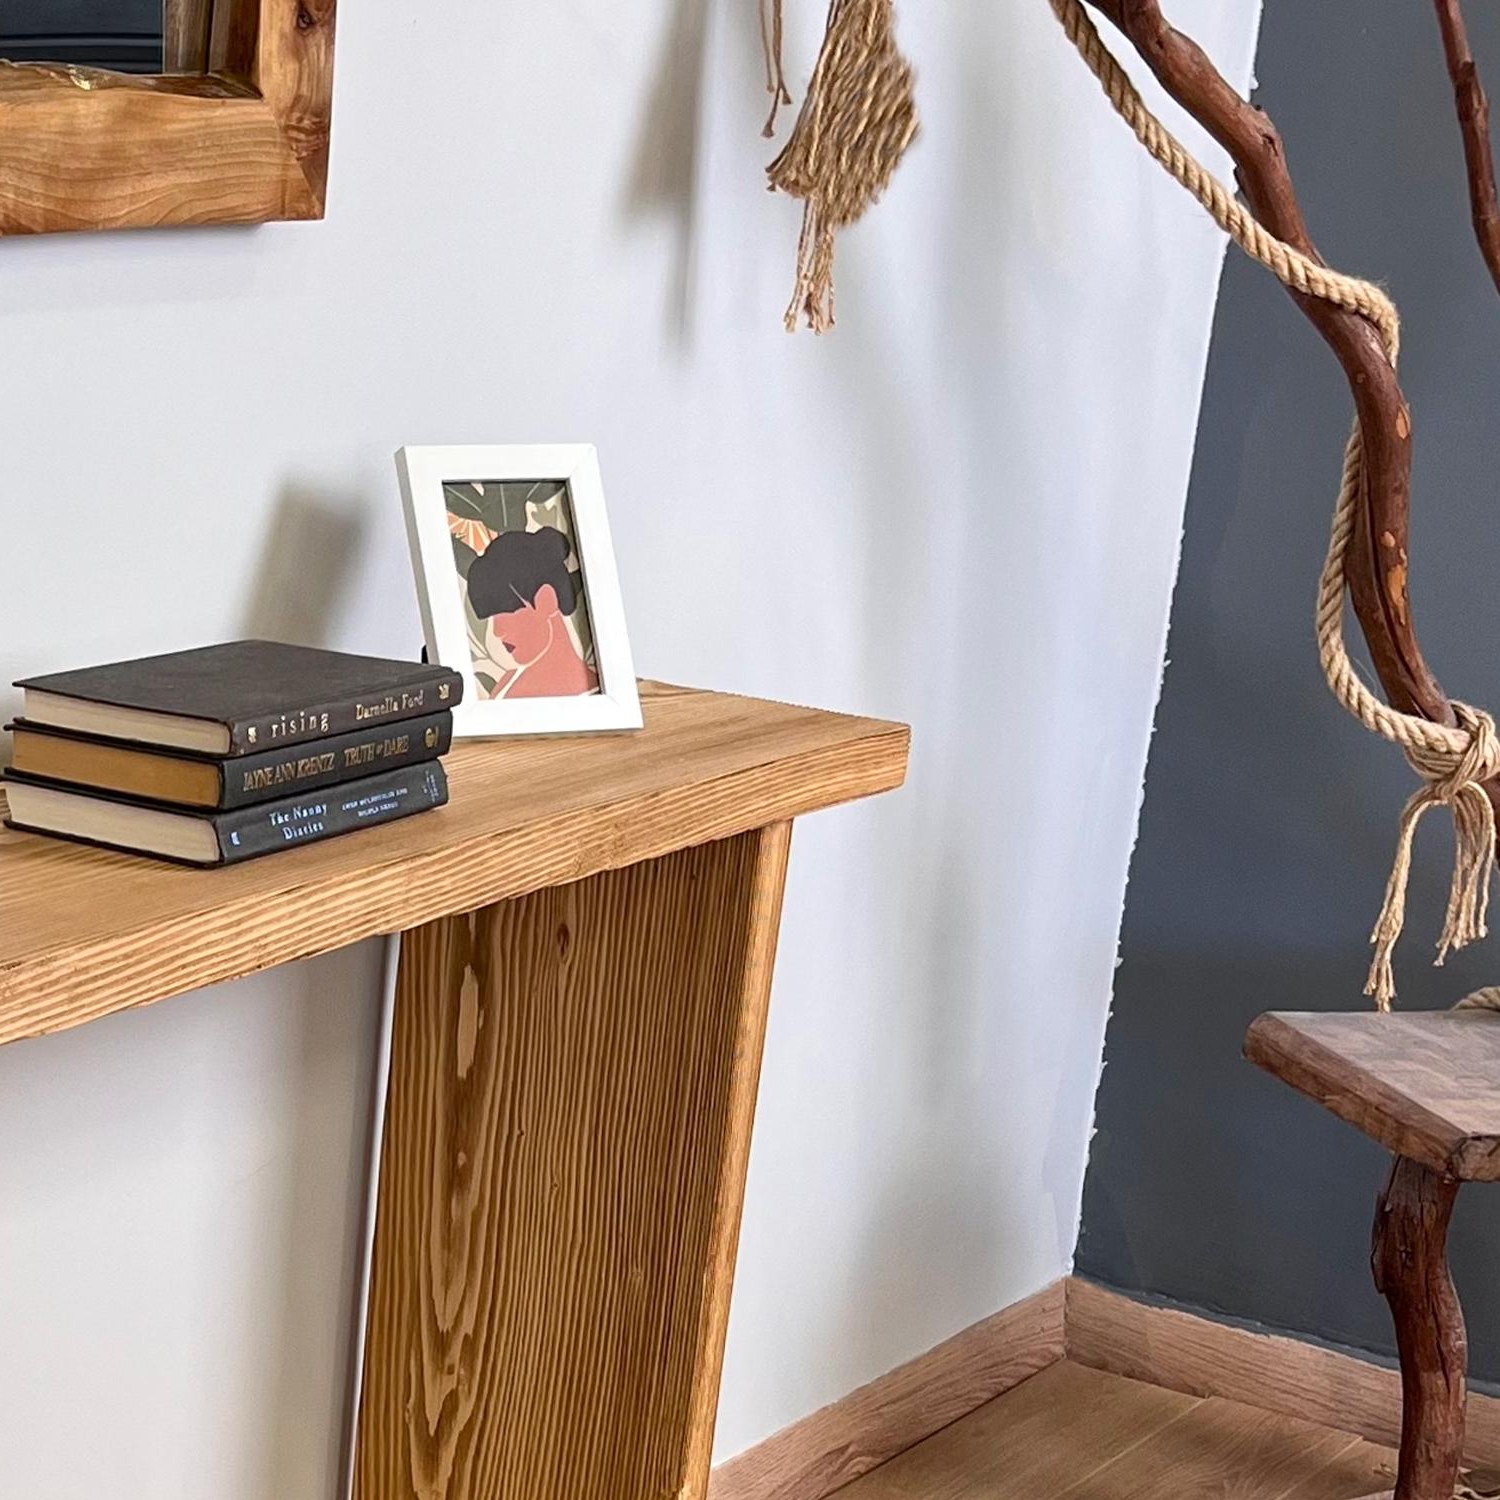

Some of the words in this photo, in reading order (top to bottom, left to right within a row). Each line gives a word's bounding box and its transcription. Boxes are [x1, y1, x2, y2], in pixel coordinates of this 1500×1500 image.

[355, 697, 399, 721] Darnella
[401, 690, 424, 710] Ford
[271, 711, 330, 738] rising
[344, 742, 375, 768] TRUTH
[383, 734, 409, 758] DARE
[243, 766, 273, 792] JAYNE
[273, 760, 296, 784] ANN
[296, 752, 335, 778] KRENTZ
[269, 812, 289, 828] The
[293, 802, 328, 821] Nanny
[283, 821, 324, 840] Diaries
